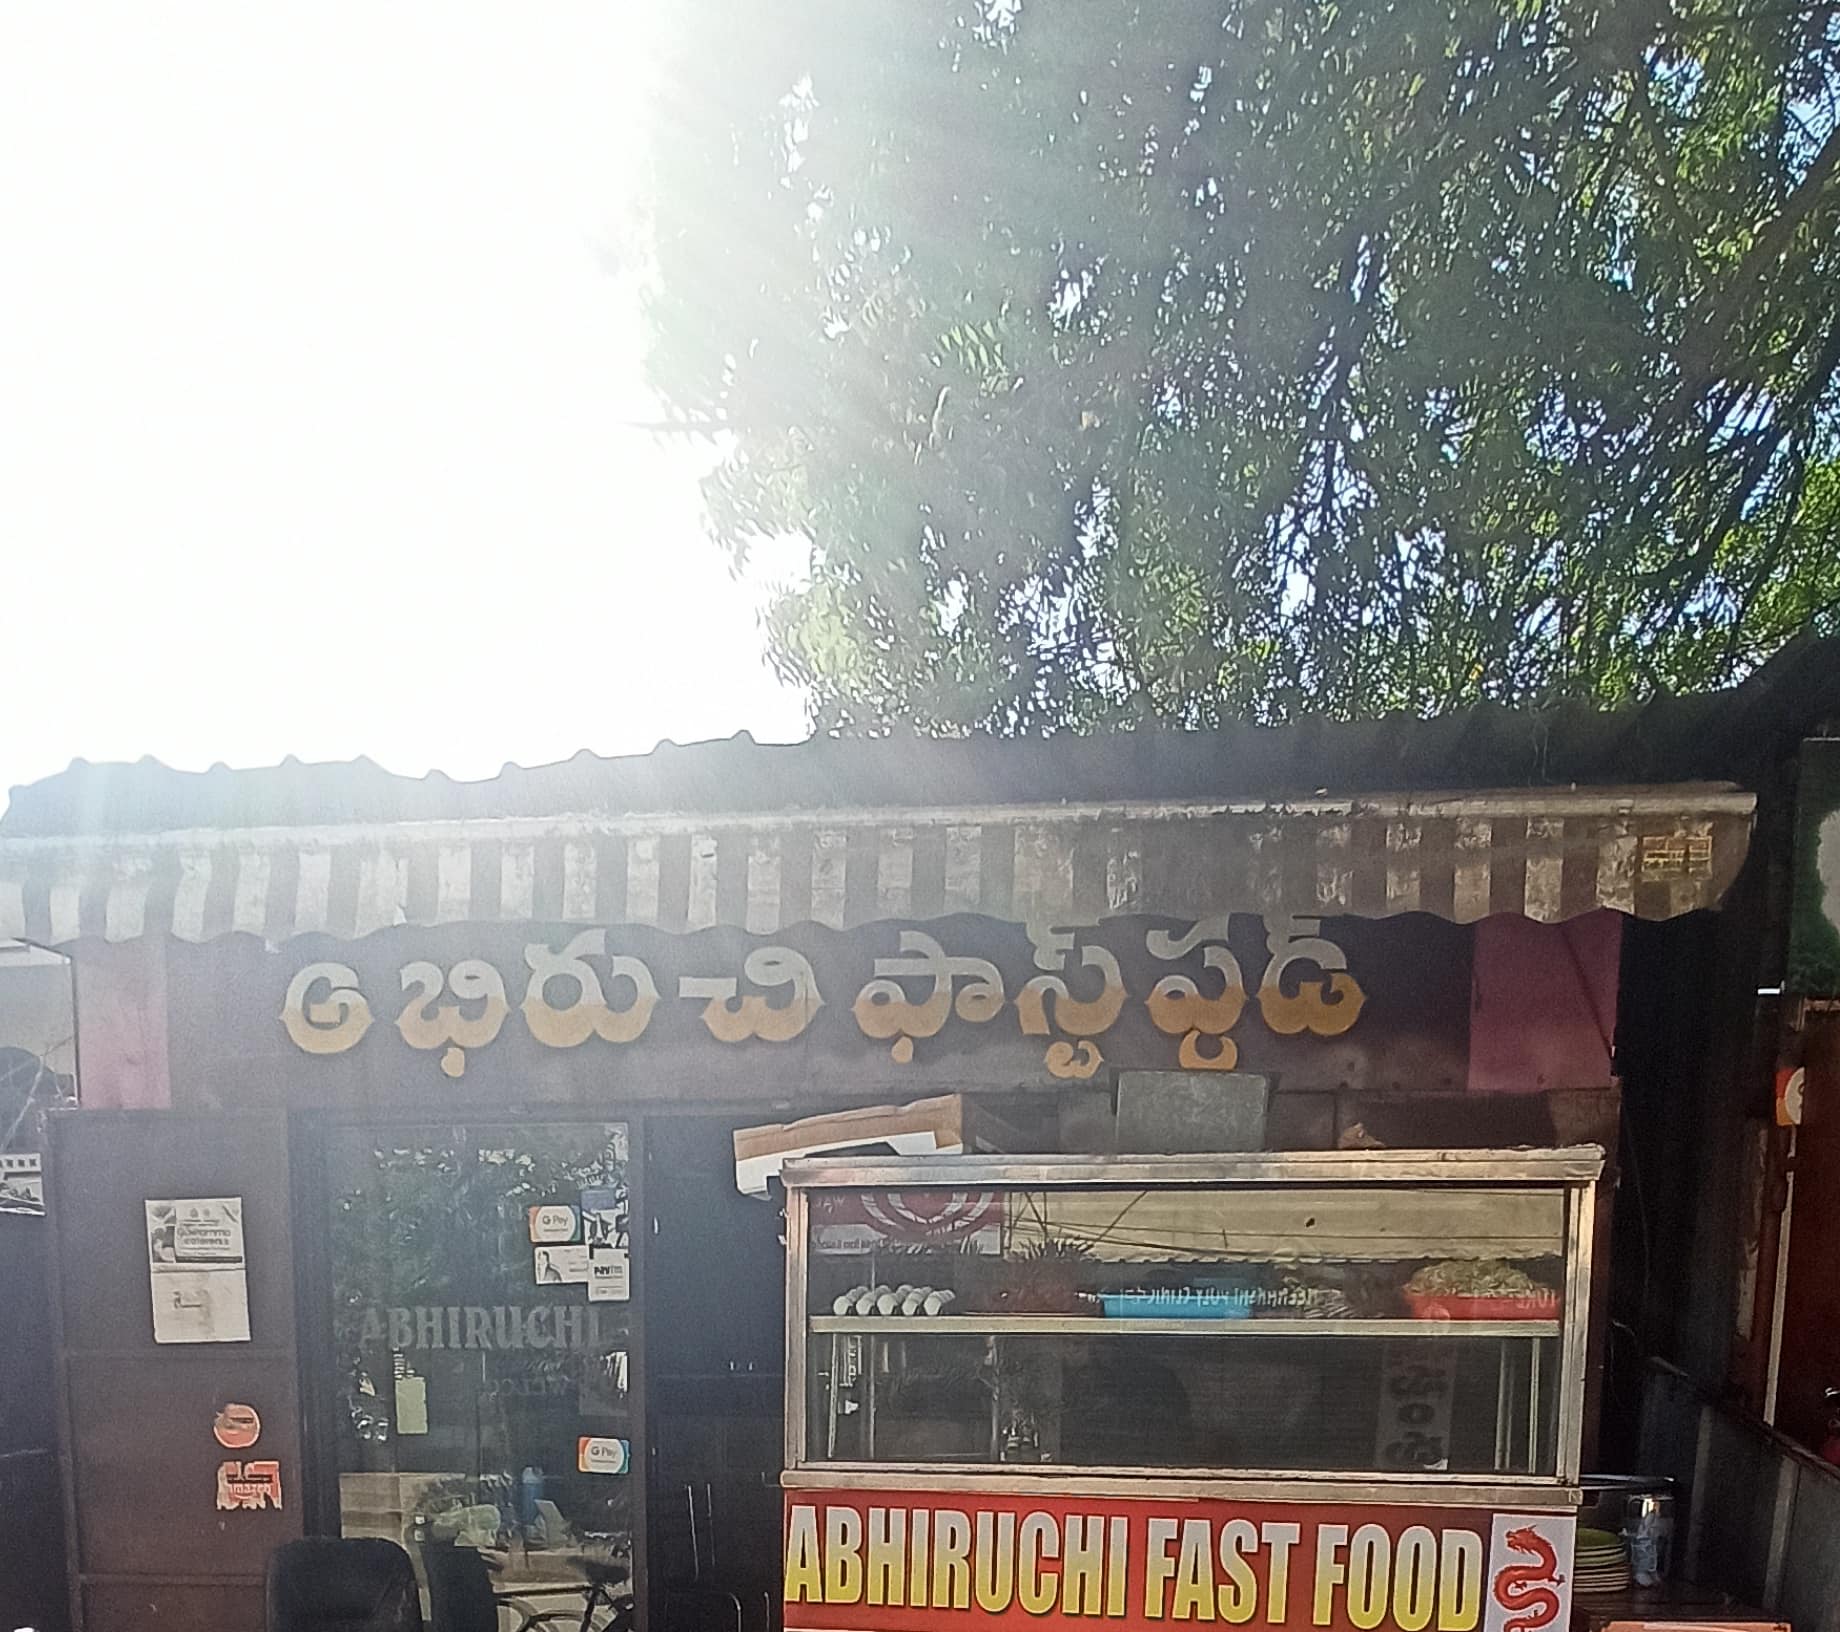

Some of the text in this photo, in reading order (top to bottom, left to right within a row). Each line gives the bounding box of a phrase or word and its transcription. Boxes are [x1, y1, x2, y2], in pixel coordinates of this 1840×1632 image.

[360, 1304, 602, 1350] ABHIRUCHI
[785, 1504, 1484, 1632] ABHIRUCHI FAST FOOD
